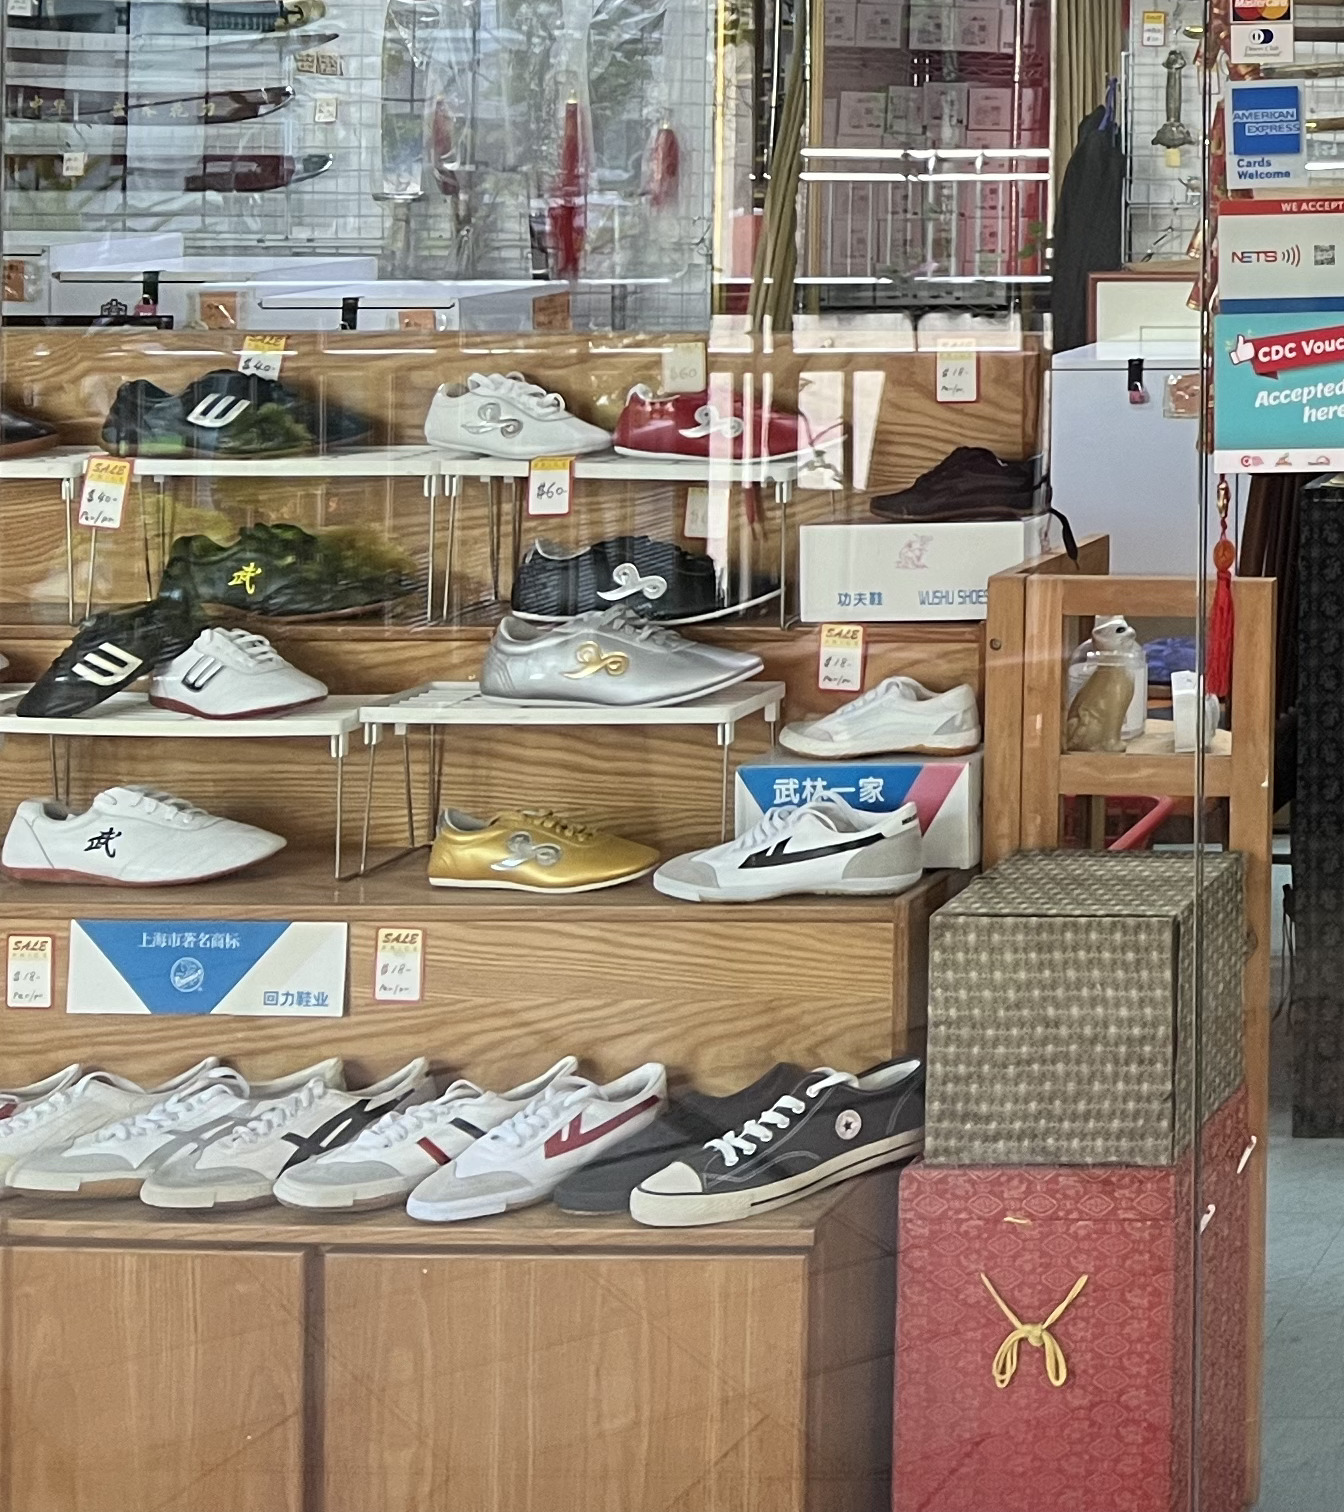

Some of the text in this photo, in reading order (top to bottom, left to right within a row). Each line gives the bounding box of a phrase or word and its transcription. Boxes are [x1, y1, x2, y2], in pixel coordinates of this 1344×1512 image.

[1233, 110, 1295, 121] AMERICAN
[1247, 123, 1300, 134] EXPRESS
[1237, 157, 1272, 168] Cards
[1237, 170, 1291, 180] Welcome
[1281, 201, 1344, 212] WE ACCEPT
[1231, 251, 1278, 264] NETS
[1258, 342, 1297, 364] CDC
[92, 462, 127, 475] SALE
[228, 562, 262, 594] 武
[837, 591, 883, 607] 功夫鞋
[918, 590, 955, 606] WUSHU
[825, 628, 860, 640] SALE
[773, 777, 885, 804] 武林一家
[84, 827, 122, 858] 武
[138, 931, 241, 949] 上海市著名商标
[382, 933, 419, 944] SALE
[13, 940, 49, 952] SALE
[263, 990, 329, 1007] 回力鞋业
